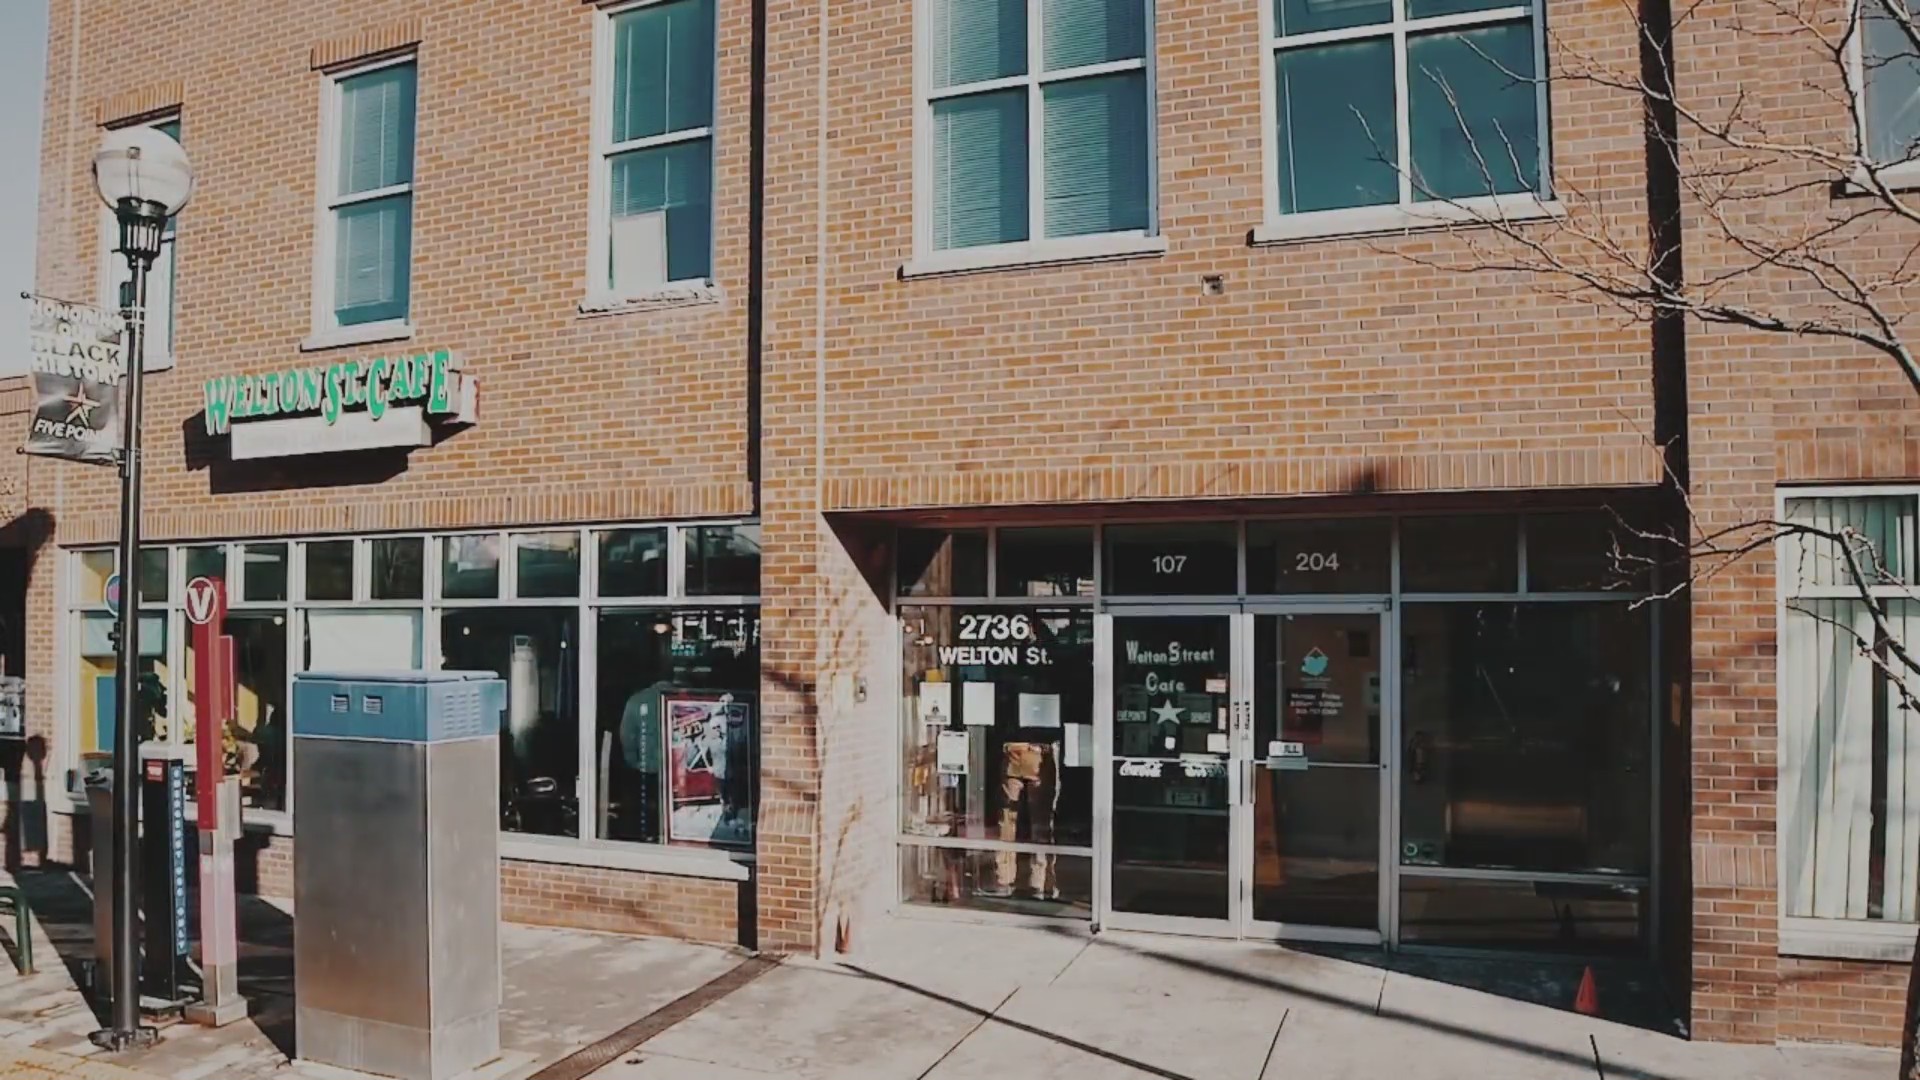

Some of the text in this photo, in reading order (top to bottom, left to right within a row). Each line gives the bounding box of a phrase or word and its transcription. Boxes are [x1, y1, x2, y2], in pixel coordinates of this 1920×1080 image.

[204, 367, 322, 436] WELTON
[365, 347, 451, 420] CAFE
[34, 418, 65, 438] FIVE
[1152, 555, 1188, 574] 107
[1295, 552, 1340, 571] 204
[958, 614, 1029, 640] 2736
[938, 646, 1054, 666] WELTON St.
[1125, 640, 1215, 666] Welton Street
[1145, 672, 1186, 696] Cafe
